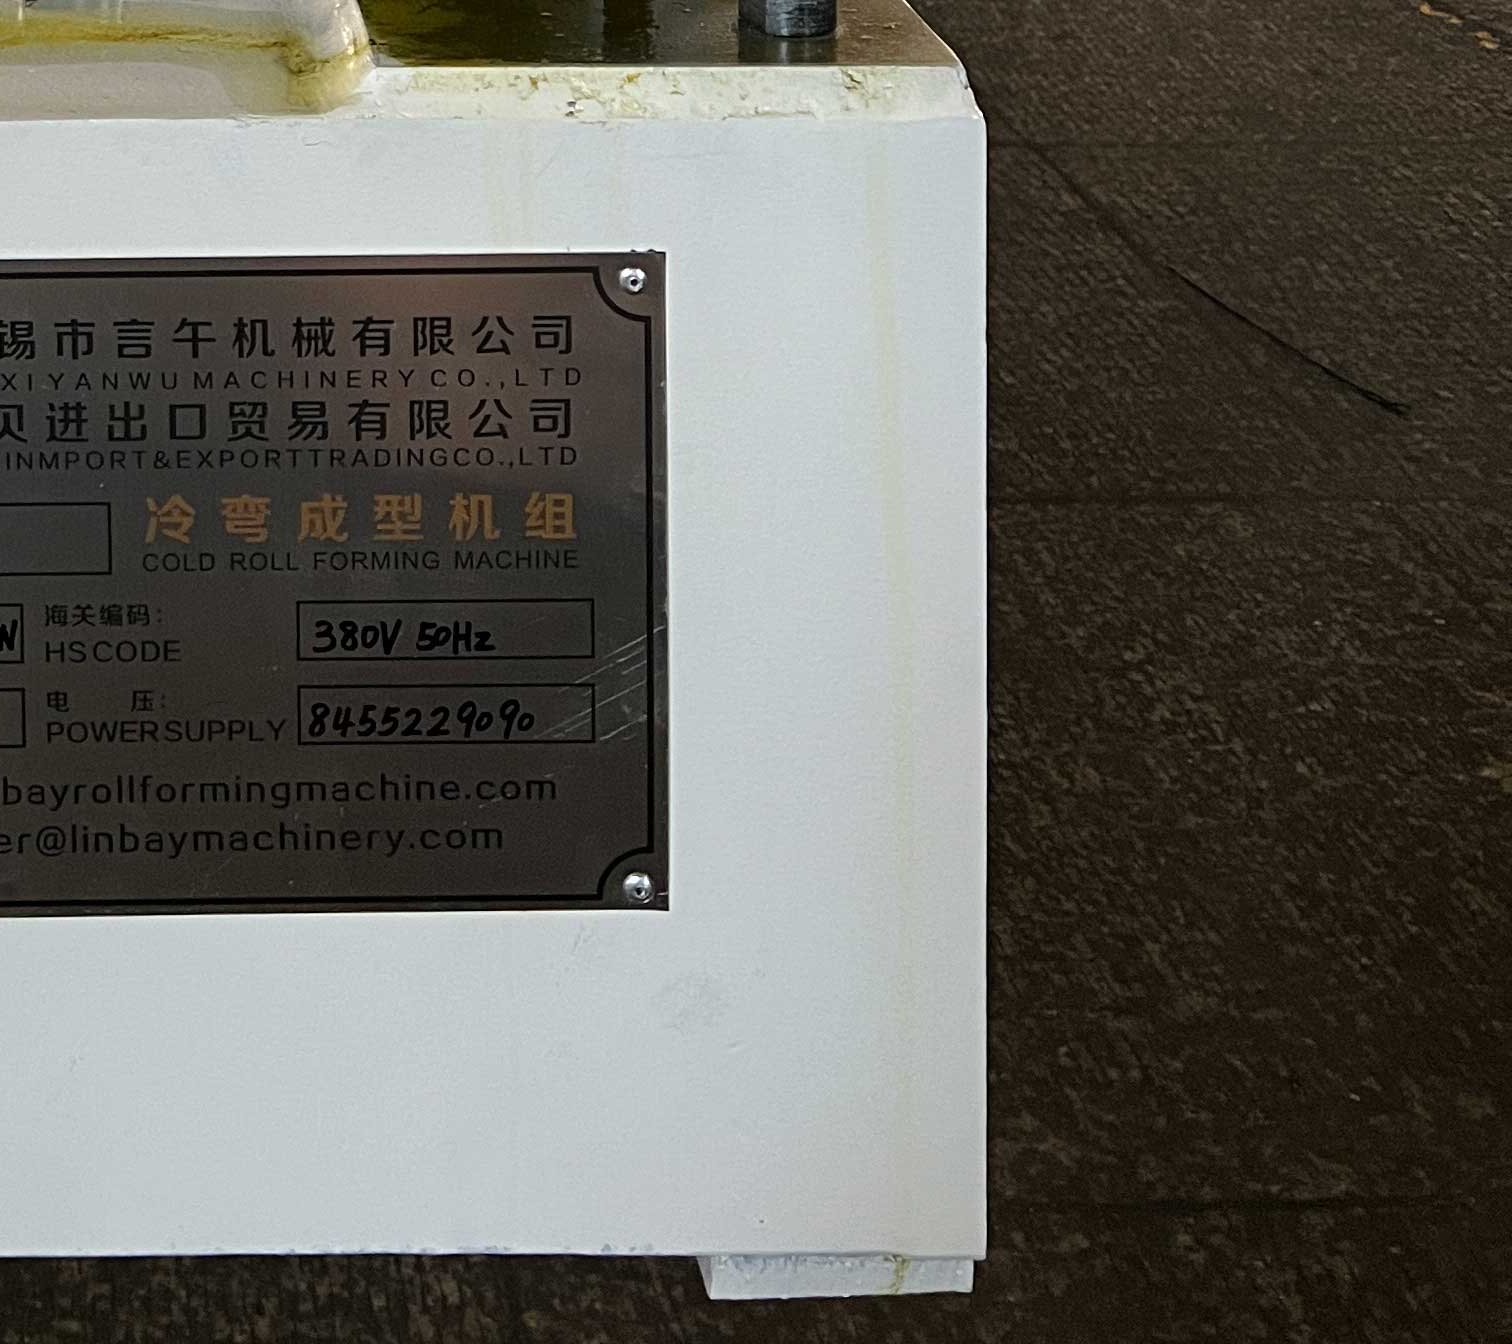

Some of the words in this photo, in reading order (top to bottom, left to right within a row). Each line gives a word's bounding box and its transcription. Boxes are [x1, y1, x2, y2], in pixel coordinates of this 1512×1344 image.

[145, 492, 578, 545] 冷弯成型机组
[143, 553, 215, 572] COLD
[230, 552, 299, 571] ROLL
[314, 551, 440, 570] FORMING
[455, 549, 578, 569] MACHINE
[313, 619, 402, 655] 380V
